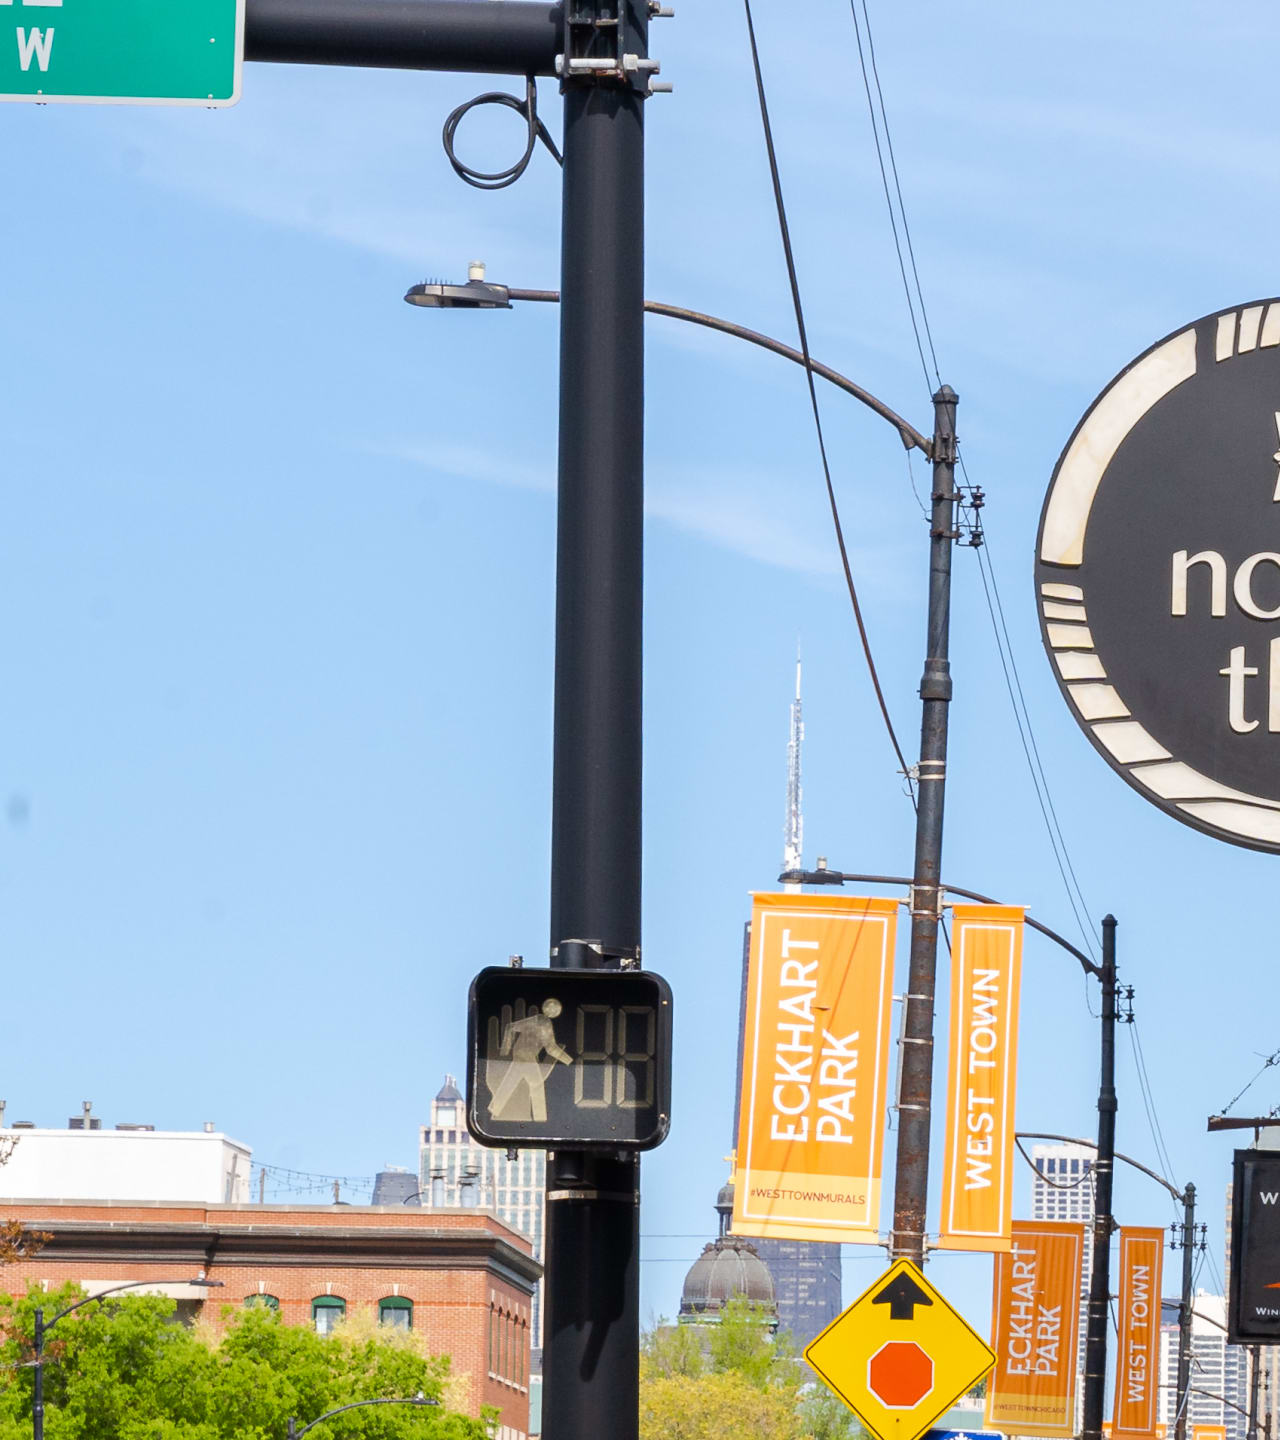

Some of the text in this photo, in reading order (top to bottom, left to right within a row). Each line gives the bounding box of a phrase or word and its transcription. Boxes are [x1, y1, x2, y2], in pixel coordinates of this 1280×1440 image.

[15, 26, 55, 72] W
[770, 928, 820, 1143] ECKHART
[815, 1028, 860, 1144] PARK
[963, 967, 1001, 1191] WEST TOWN
[750, 1187, 866, 1206] #WESTTOWNMURALS
[1006, 1241, 1037, 1376] ECKHART
[1034, 1304, 1062, 1377] PARK
[1127, 1264, 1150, 1404] WEST TOWN
